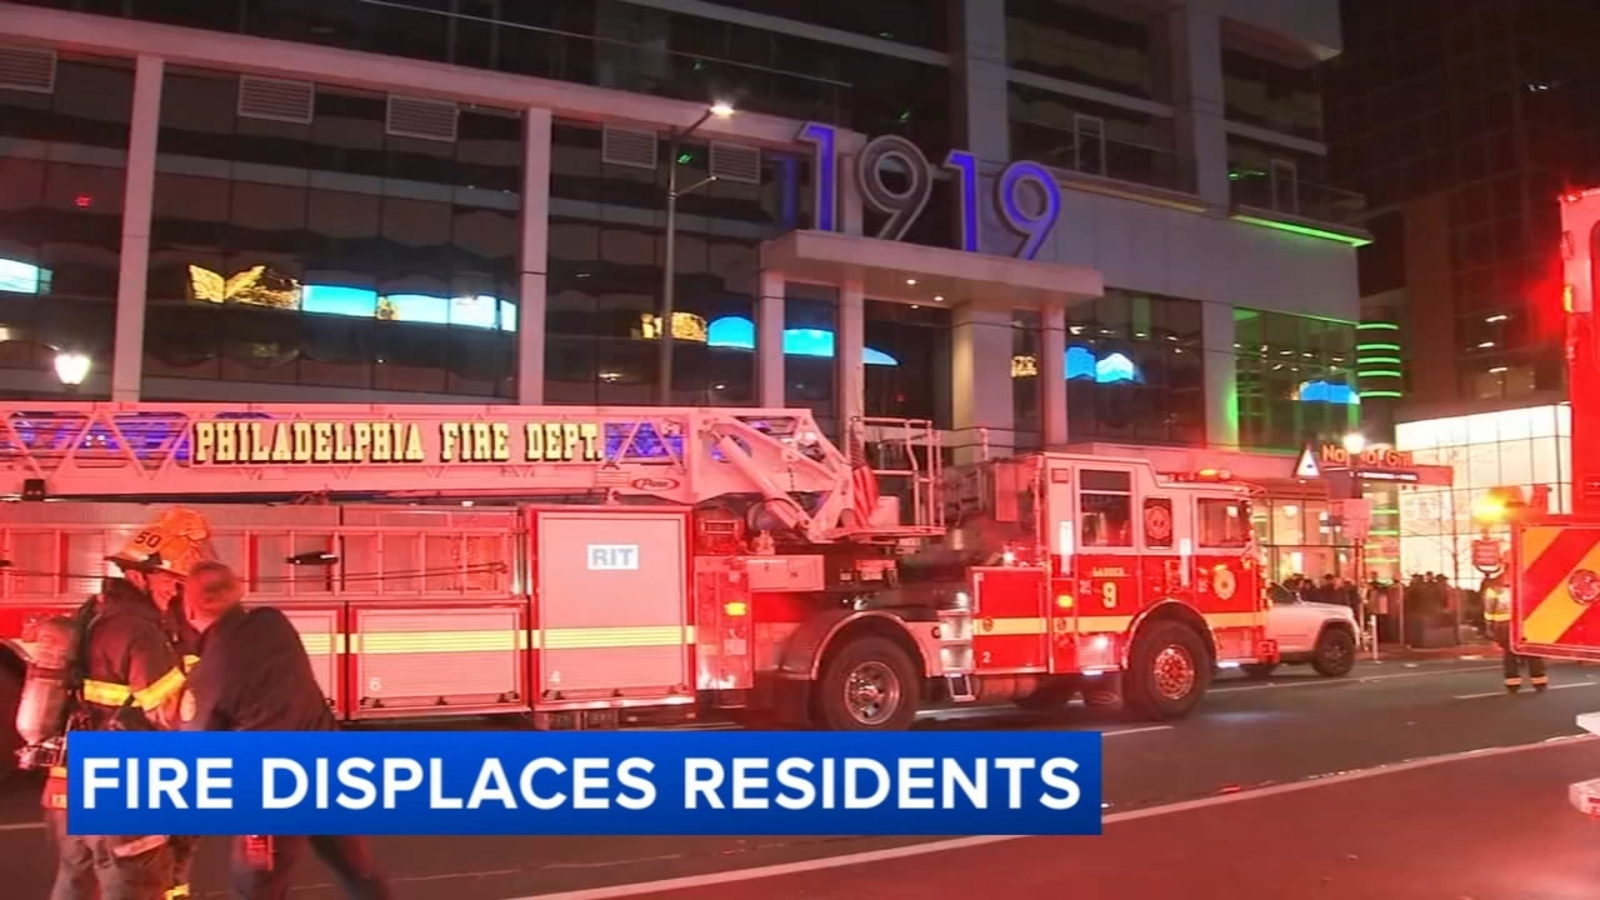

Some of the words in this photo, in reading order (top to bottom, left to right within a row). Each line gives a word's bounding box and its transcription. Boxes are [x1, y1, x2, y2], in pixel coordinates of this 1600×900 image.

[798, 122, 1062, 261] 1919
[193, 421, 425, 464] PHILADELPHIA
[440, 422, 509, 462] FIRE
[524, 422, 603, 462] DEPT.
[134, 530, 162, 549] 50
[592, 548, 634, 567] RIT
[1102, 582, 1117, 609] 9
[982, 650, 992, 664] 2
[369, 677, 381, 692] 6
